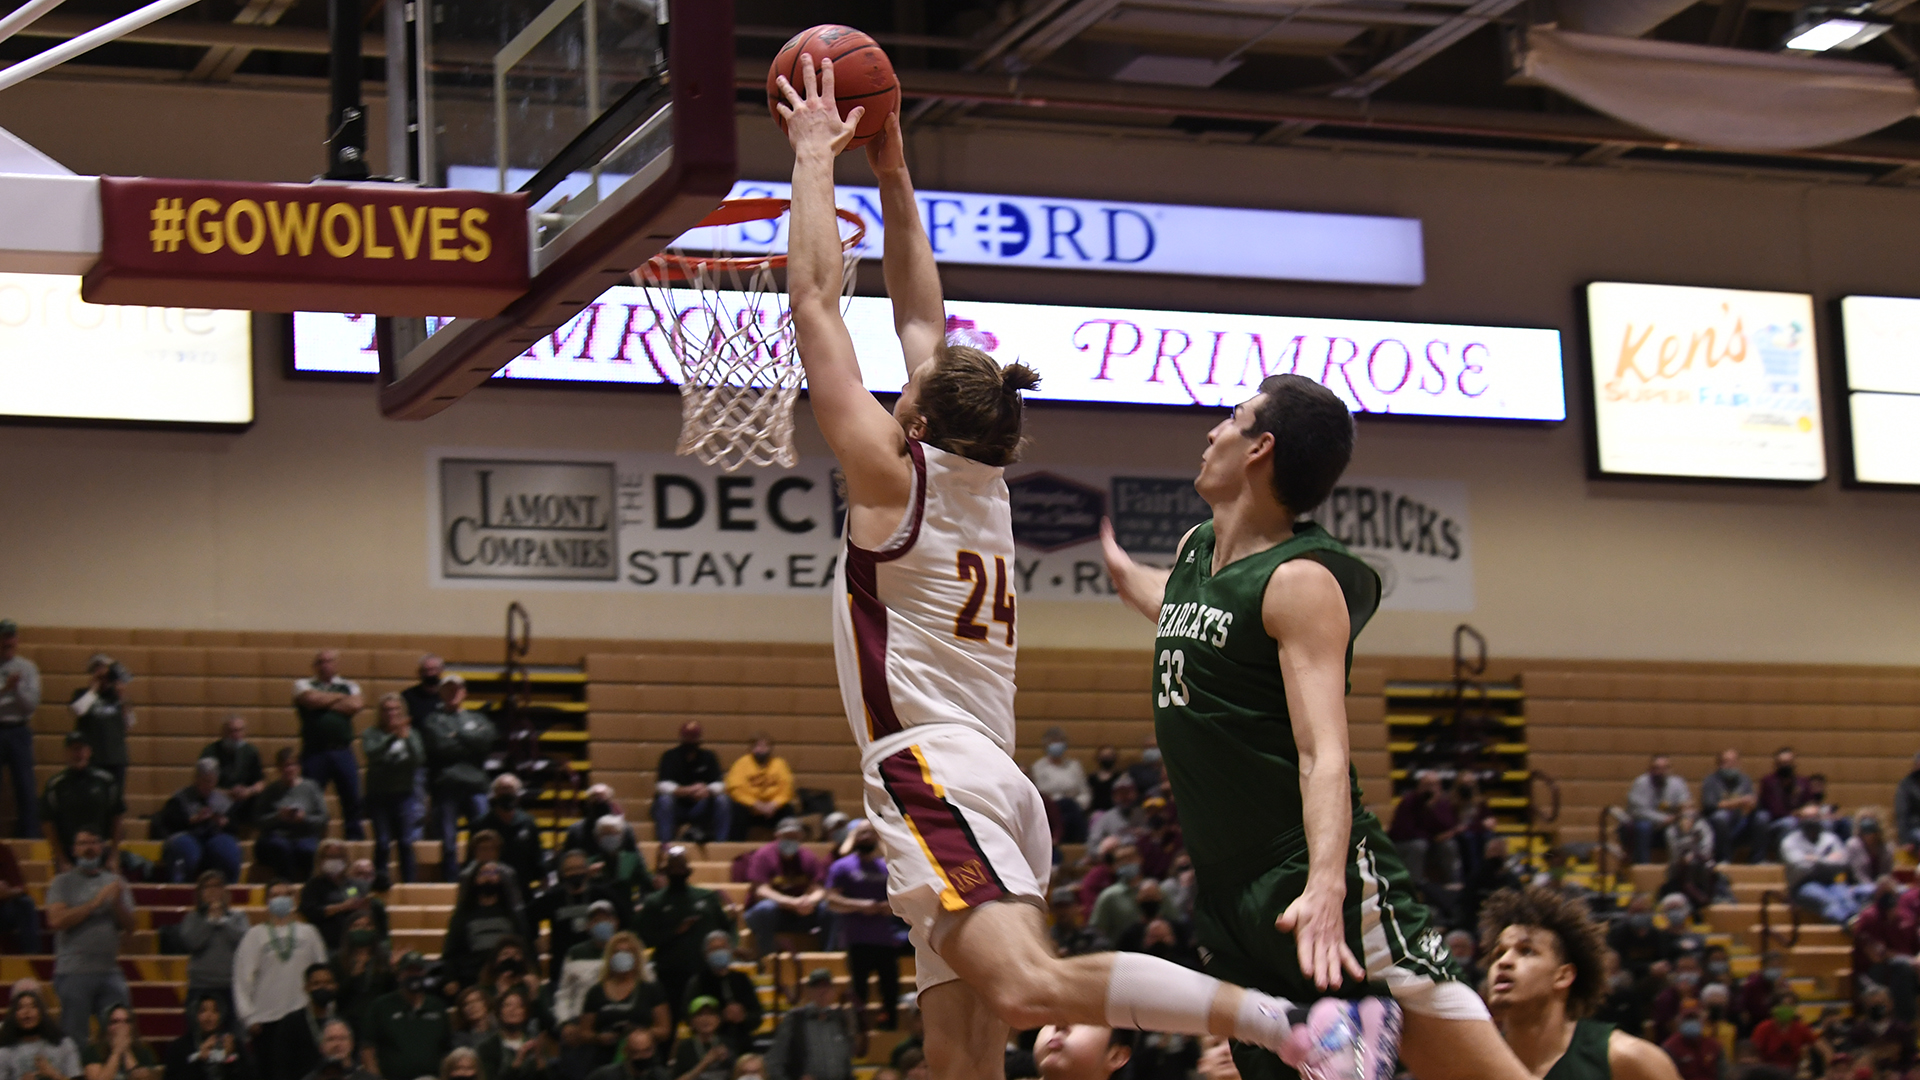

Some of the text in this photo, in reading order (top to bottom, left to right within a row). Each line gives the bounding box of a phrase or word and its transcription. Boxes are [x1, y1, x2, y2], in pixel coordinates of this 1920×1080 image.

[149, 197, 493, 262] #GOWOLVES
[1073, 318, 1491, 413] PRIMROSE
[1613, 302, 1748, 383] Ken's
[477, 470, 607, 531] LAMONT
[449, 516, 611, 569] COMPANIES
[628, 550, 753, 586] STAY
[954, 549, 1016, 648] 24
[1157, 649, 1190, 708] 33
